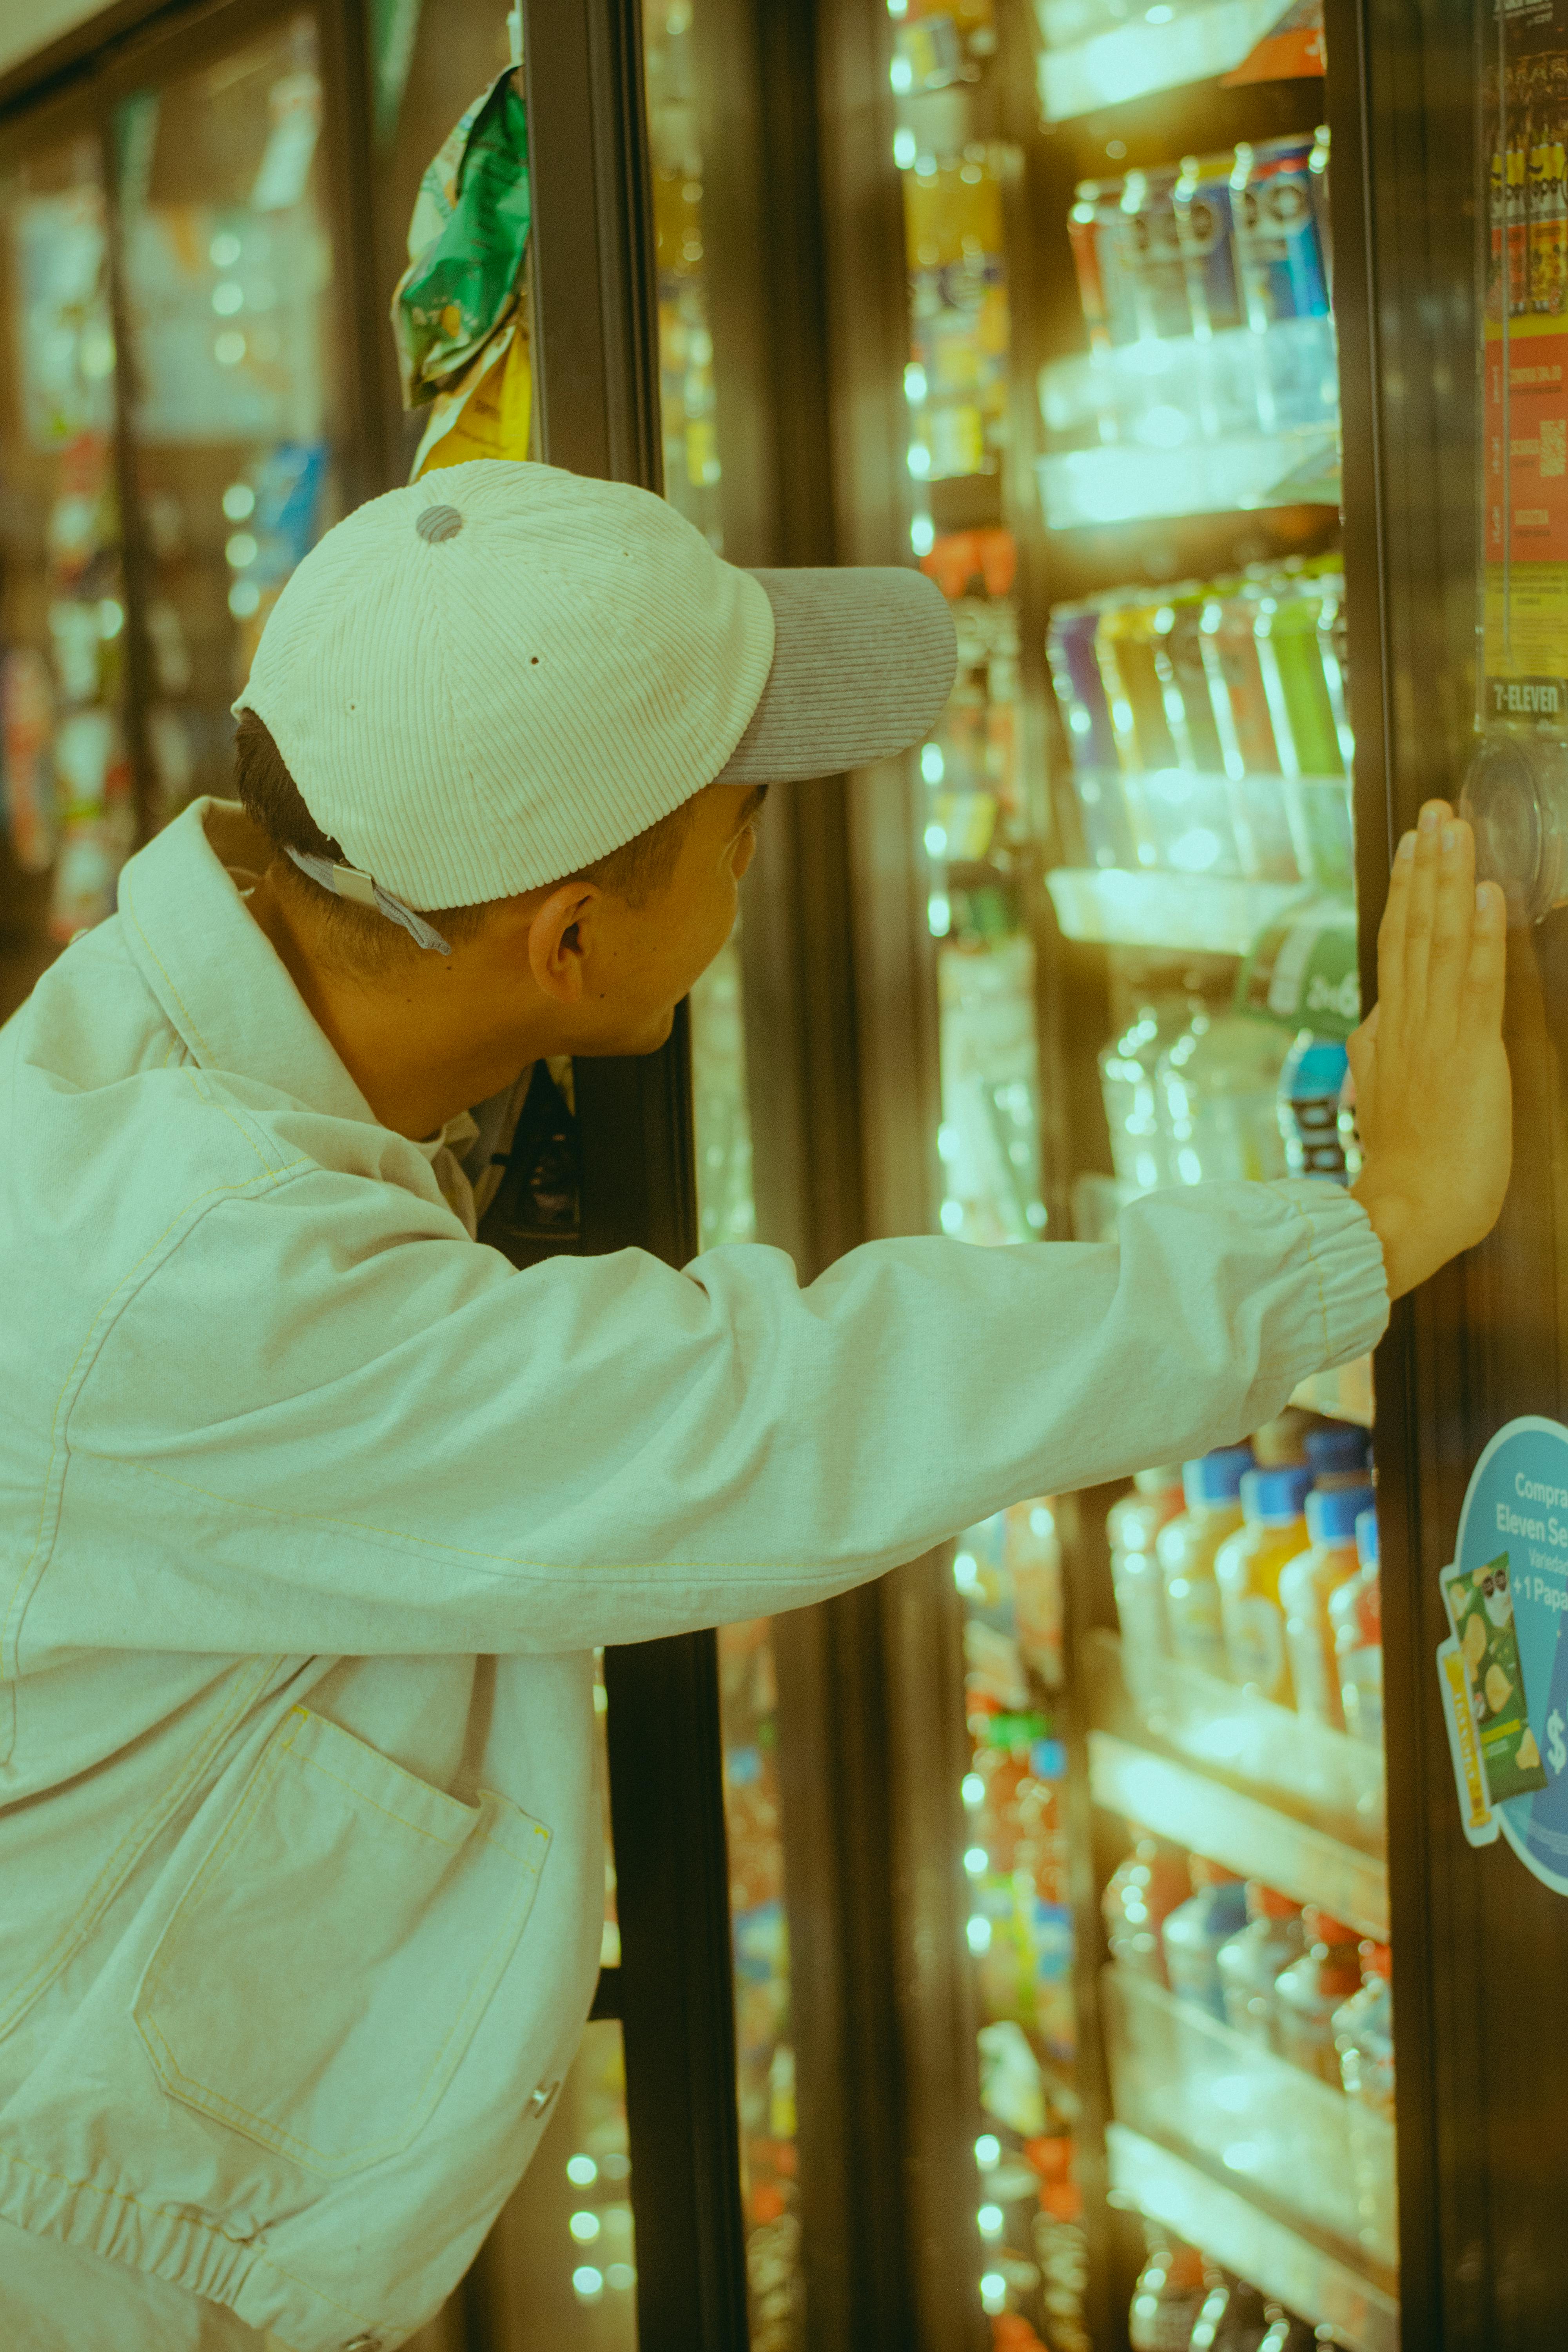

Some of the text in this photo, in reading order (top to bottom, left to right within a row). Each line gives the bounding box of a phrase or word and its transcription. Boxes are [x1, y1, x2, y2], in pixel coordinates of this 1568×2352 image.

[1494, 684, 1559, 712] 7-ELEVEN
[1515, 1473, 1568, 1509] Compra
[1496, 1503, 1545, 1543] Eleven
[1534, 1577, 1568, 1613] Papa
